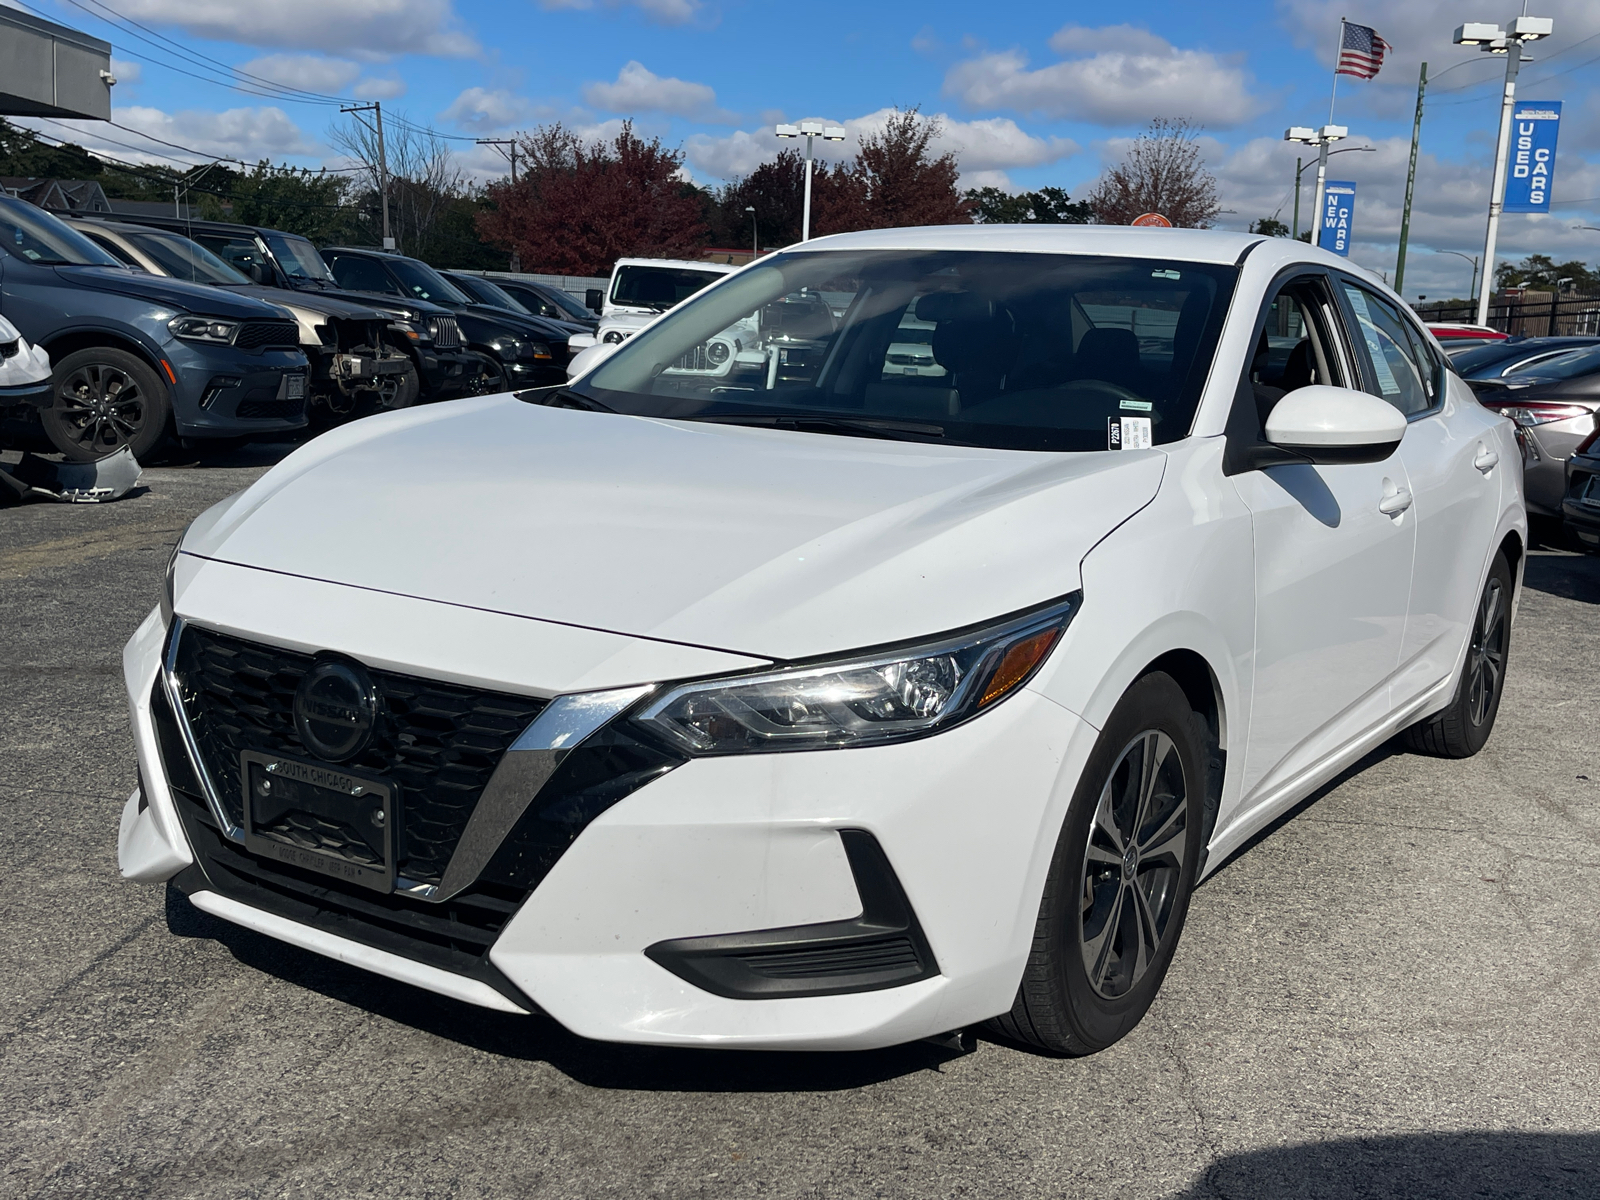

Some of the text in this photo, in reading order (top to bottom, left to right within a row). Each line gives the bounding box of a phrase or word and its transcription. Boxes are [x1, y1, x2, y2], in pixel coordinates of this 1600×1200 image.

[1513, 122, 1535, 178] USED
[1529, 148, 1550, 204] CARS
[1325, 195, 1339, 229] NEW
[1335, 207, 1349, 251] CARS
[302, 698, 360, 724] NISSAN
[276, 760, 353, 792] SOUTH CHICAGO
